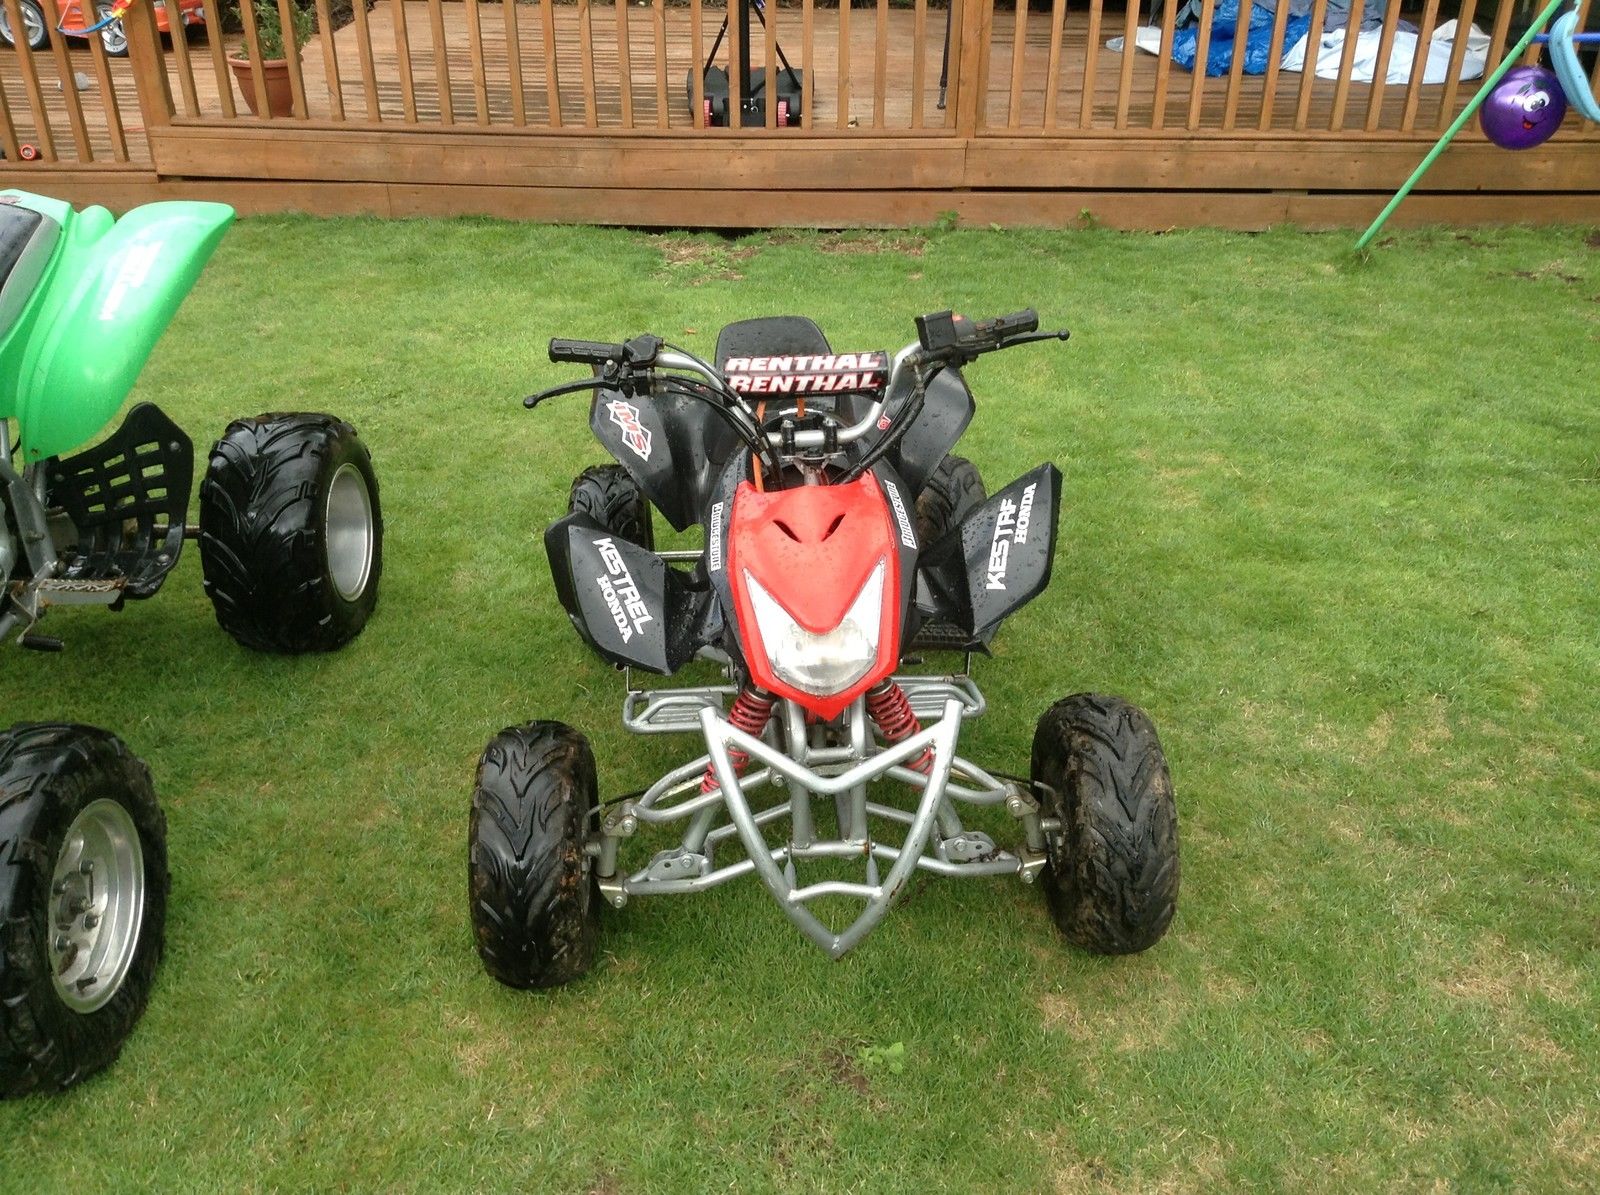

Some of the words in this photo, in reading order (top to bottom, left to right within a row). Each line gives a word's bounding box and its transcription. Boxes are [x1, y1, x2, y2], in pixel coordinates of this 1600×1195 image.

[725, 353, 881, 372] RENTHAL
[727, 371, 880, 393] RENTHAL
[1014, 482, 1037, 544] HONDA
[592, 537, 654, 635] KESTREL
[596, 574, 633, 644] HONDA
